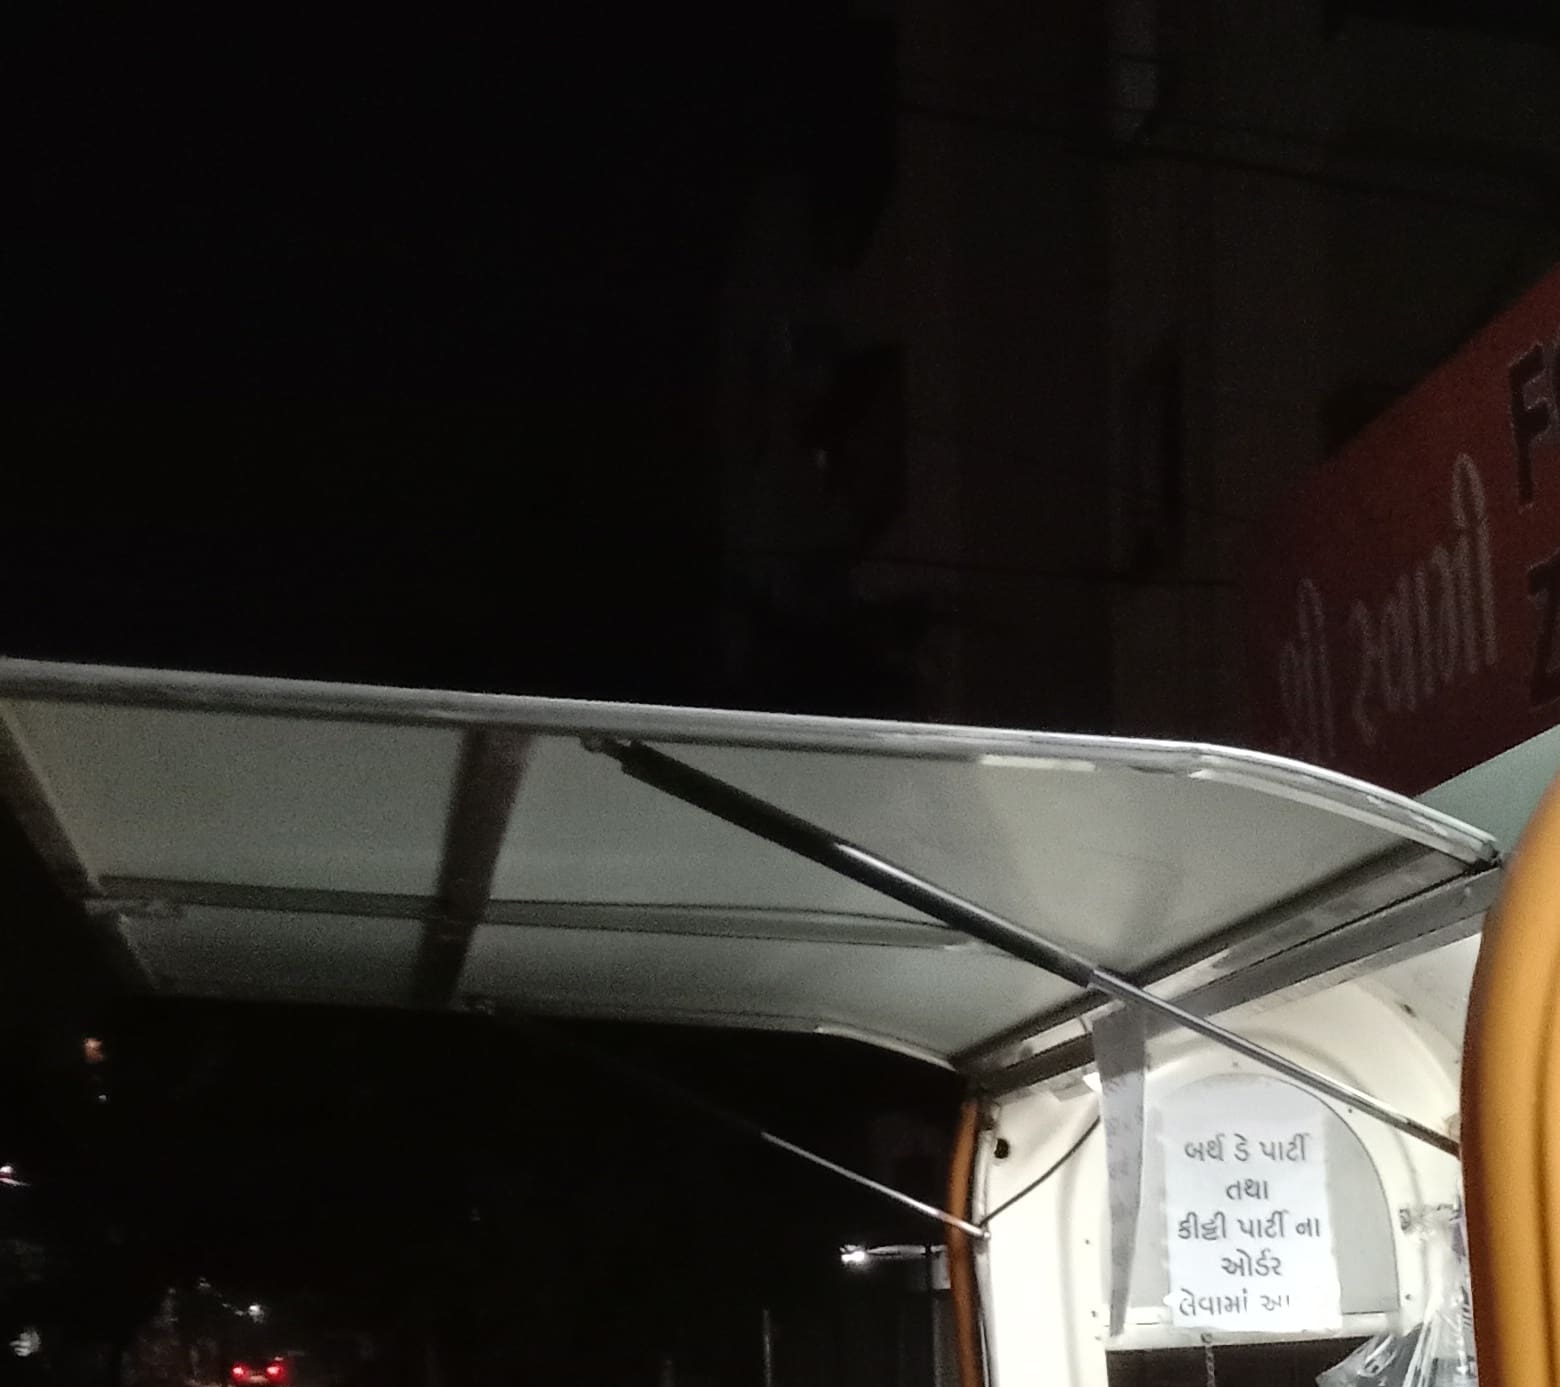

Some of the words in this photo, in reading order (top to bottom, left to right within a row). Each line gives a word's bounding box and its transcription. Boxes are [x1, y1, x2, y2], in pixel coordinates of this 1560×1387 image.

[1184, 1133, 1224, 1161] બર્થ
[1234, 1133, 1249, 1161] ડે
[1259, 1133, 1310, 1161] પાર્ટી
[1226, 1179, 1268, 1200] તથા
[1237, 1209, 1289, 1238] પાર્ટી
[1295, 1218, 1320, 1238] ના
[1221, 1248, 1282, 1276] ઓર્ડર
[1180, 1288, 1247, 1316] લેવામાં
